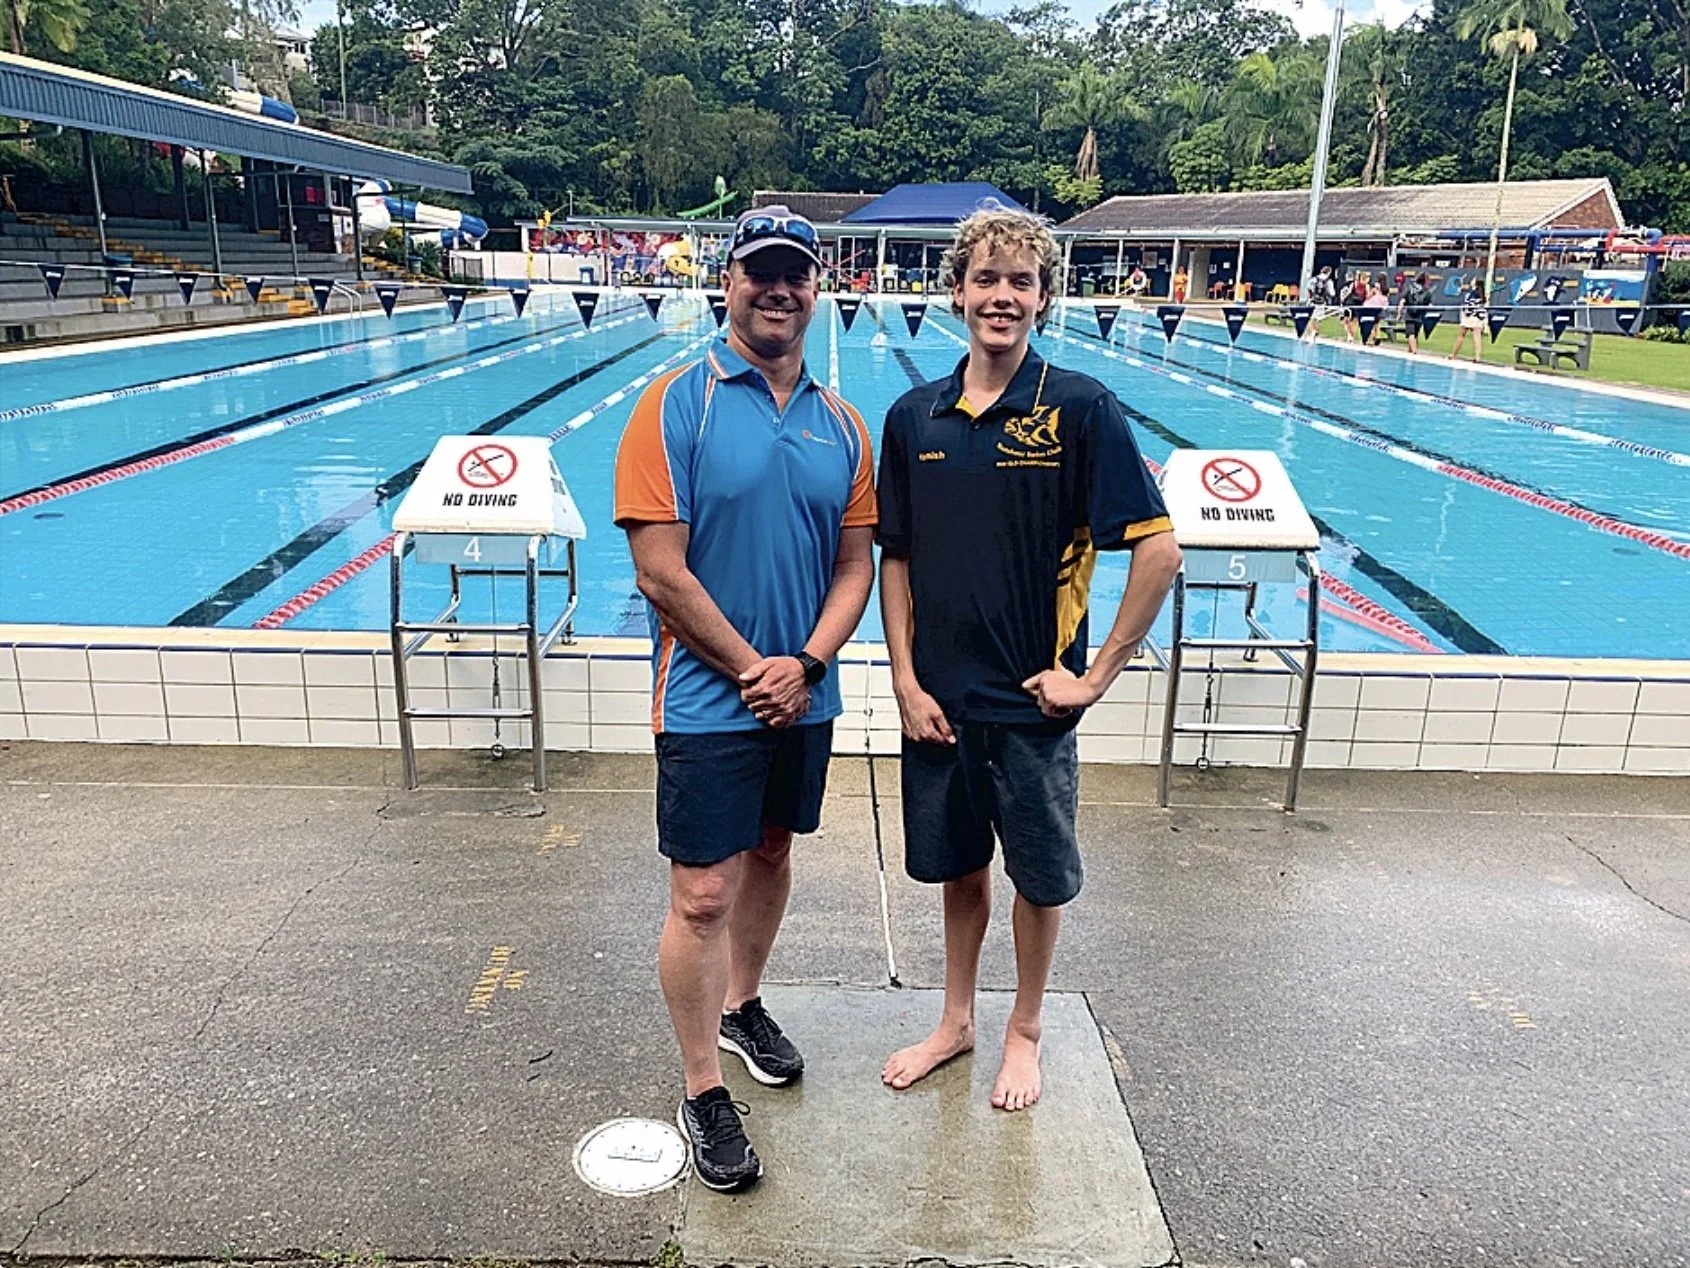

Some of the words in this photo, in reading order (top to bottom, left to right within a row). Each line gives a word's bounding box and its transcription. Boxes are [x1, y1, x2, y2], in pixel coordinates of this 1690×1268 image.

[442, 492, 463, 506] NO
[467, 493, 518, 507] DIVING
[1200, 507, 1221, 520] NO
[1225, 508, 1275, 522] DIVING
[463, 536, 482, 562] 4
[1228, 555, 1246, 580] 5
